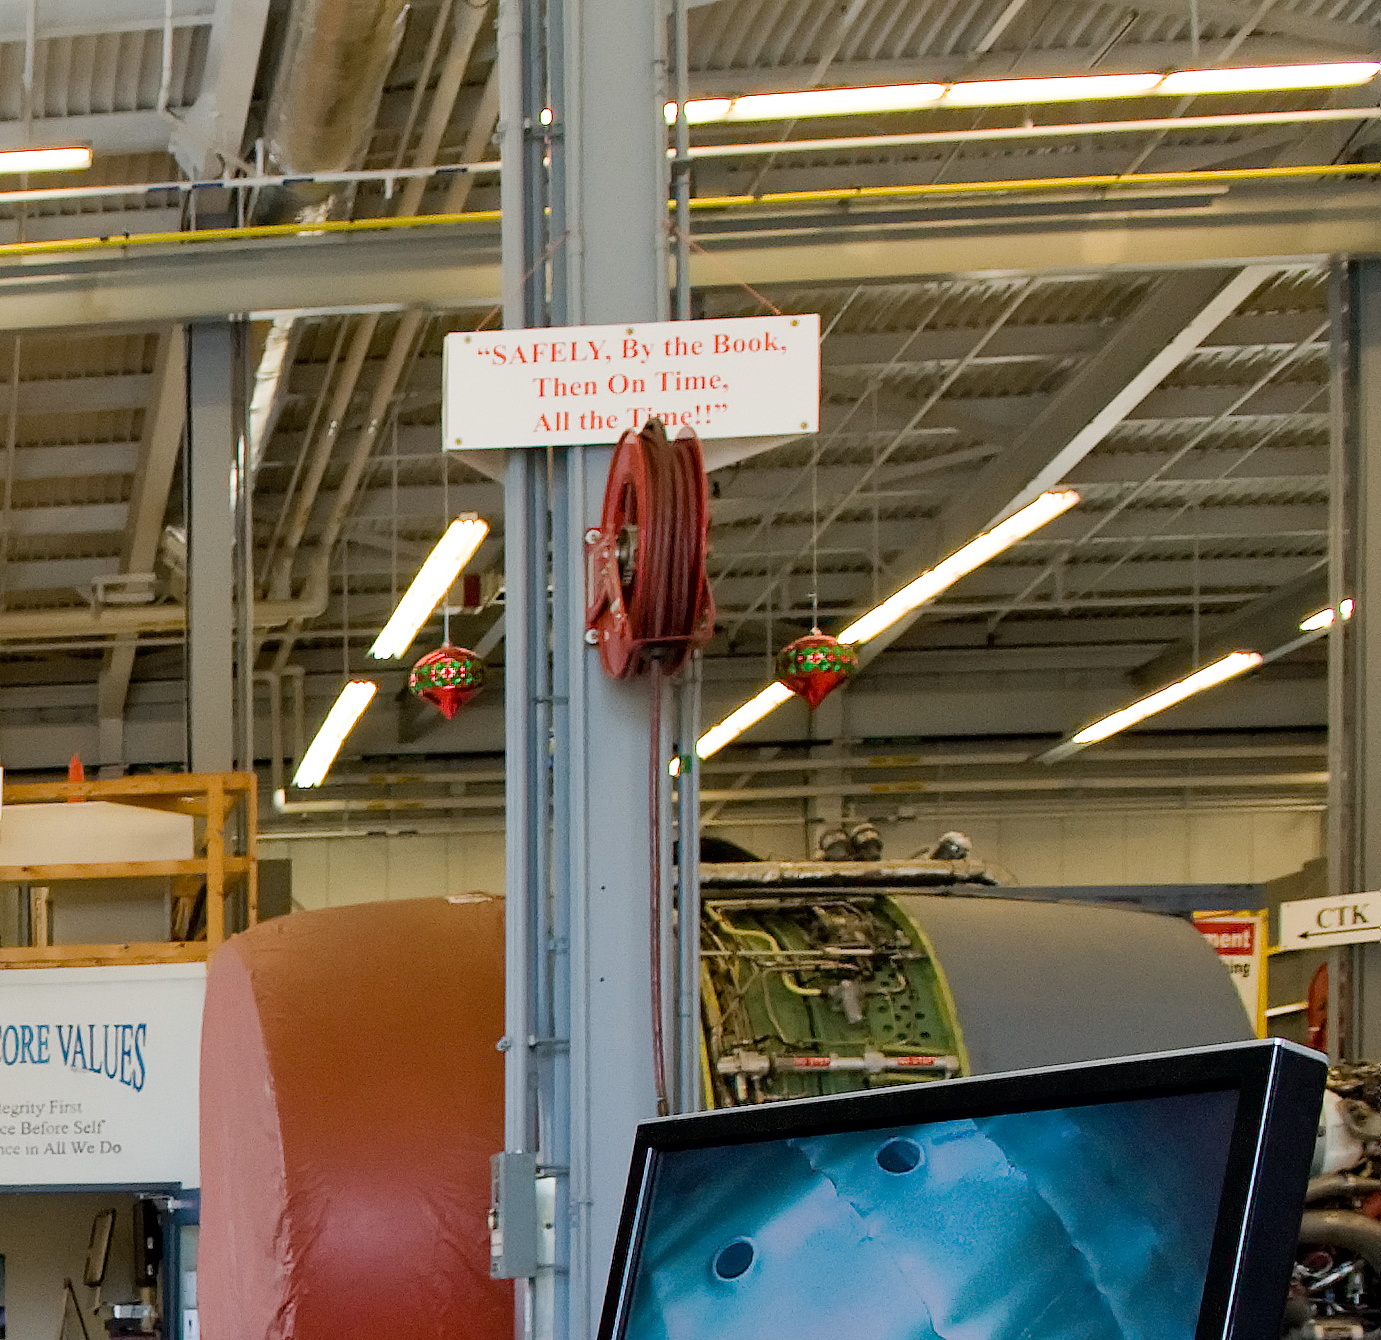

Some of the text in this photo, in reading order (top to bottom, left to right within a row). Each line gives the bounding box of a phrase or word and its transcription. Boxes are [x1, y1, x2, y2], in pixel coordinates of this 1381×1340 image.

[622, 338, 651, 364] By
[665, 334, 704, 357] the
[714, 331, 788, 354] Book,
[533, 371, 730, 398] Then On Time,
[533, 411, 570, 433] All
[580, 411, 619, 431] the
[1316, 903, 1371, 929] CTK
[56, 1022, 147, 1092] VALUES
[49, 1099, 83, 1115] First
[21, 1121, 69, 1136] Before
[73, 1120, 103, 1135] Self
[43, 1142, 66, 1156] All
[71, 1142, 96, 1155] We
[100, 1141, 122, 1155] Do
